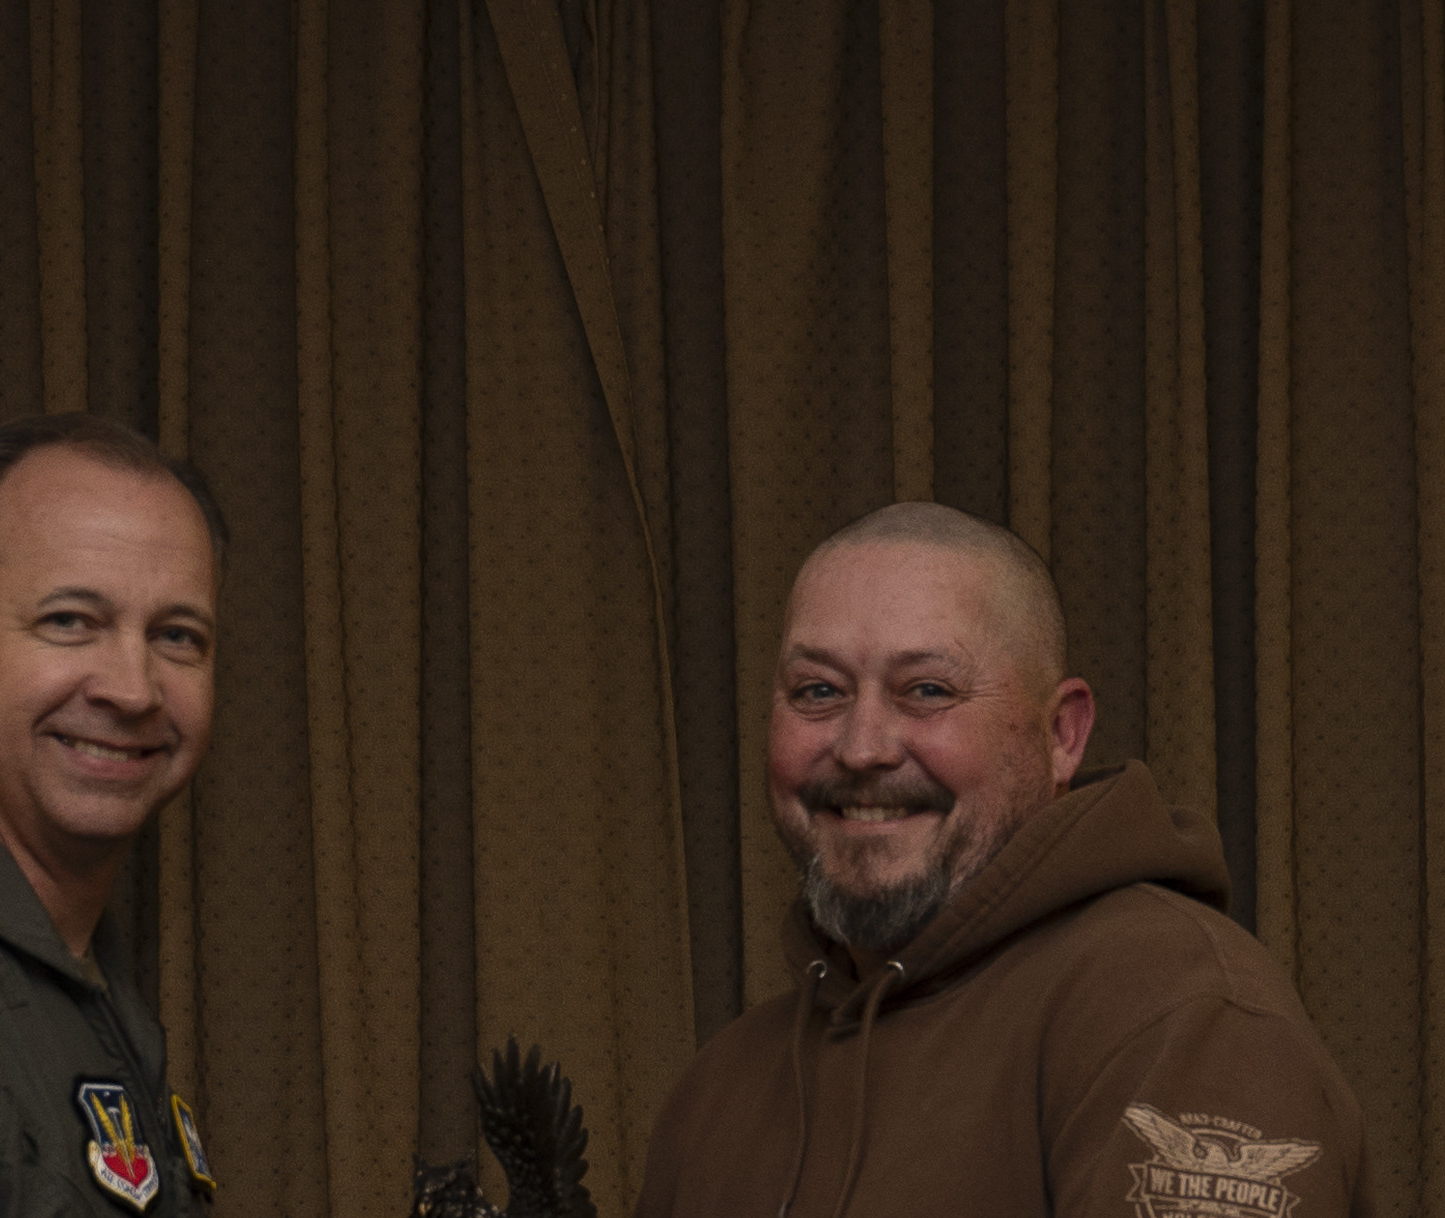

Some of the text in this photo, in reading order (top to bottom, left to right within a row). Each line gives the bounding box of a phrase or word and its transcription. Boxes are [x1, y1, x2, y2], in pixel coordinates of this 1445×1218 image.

[1150, 1167, 1281, 1211] WE THE PEOPLE
